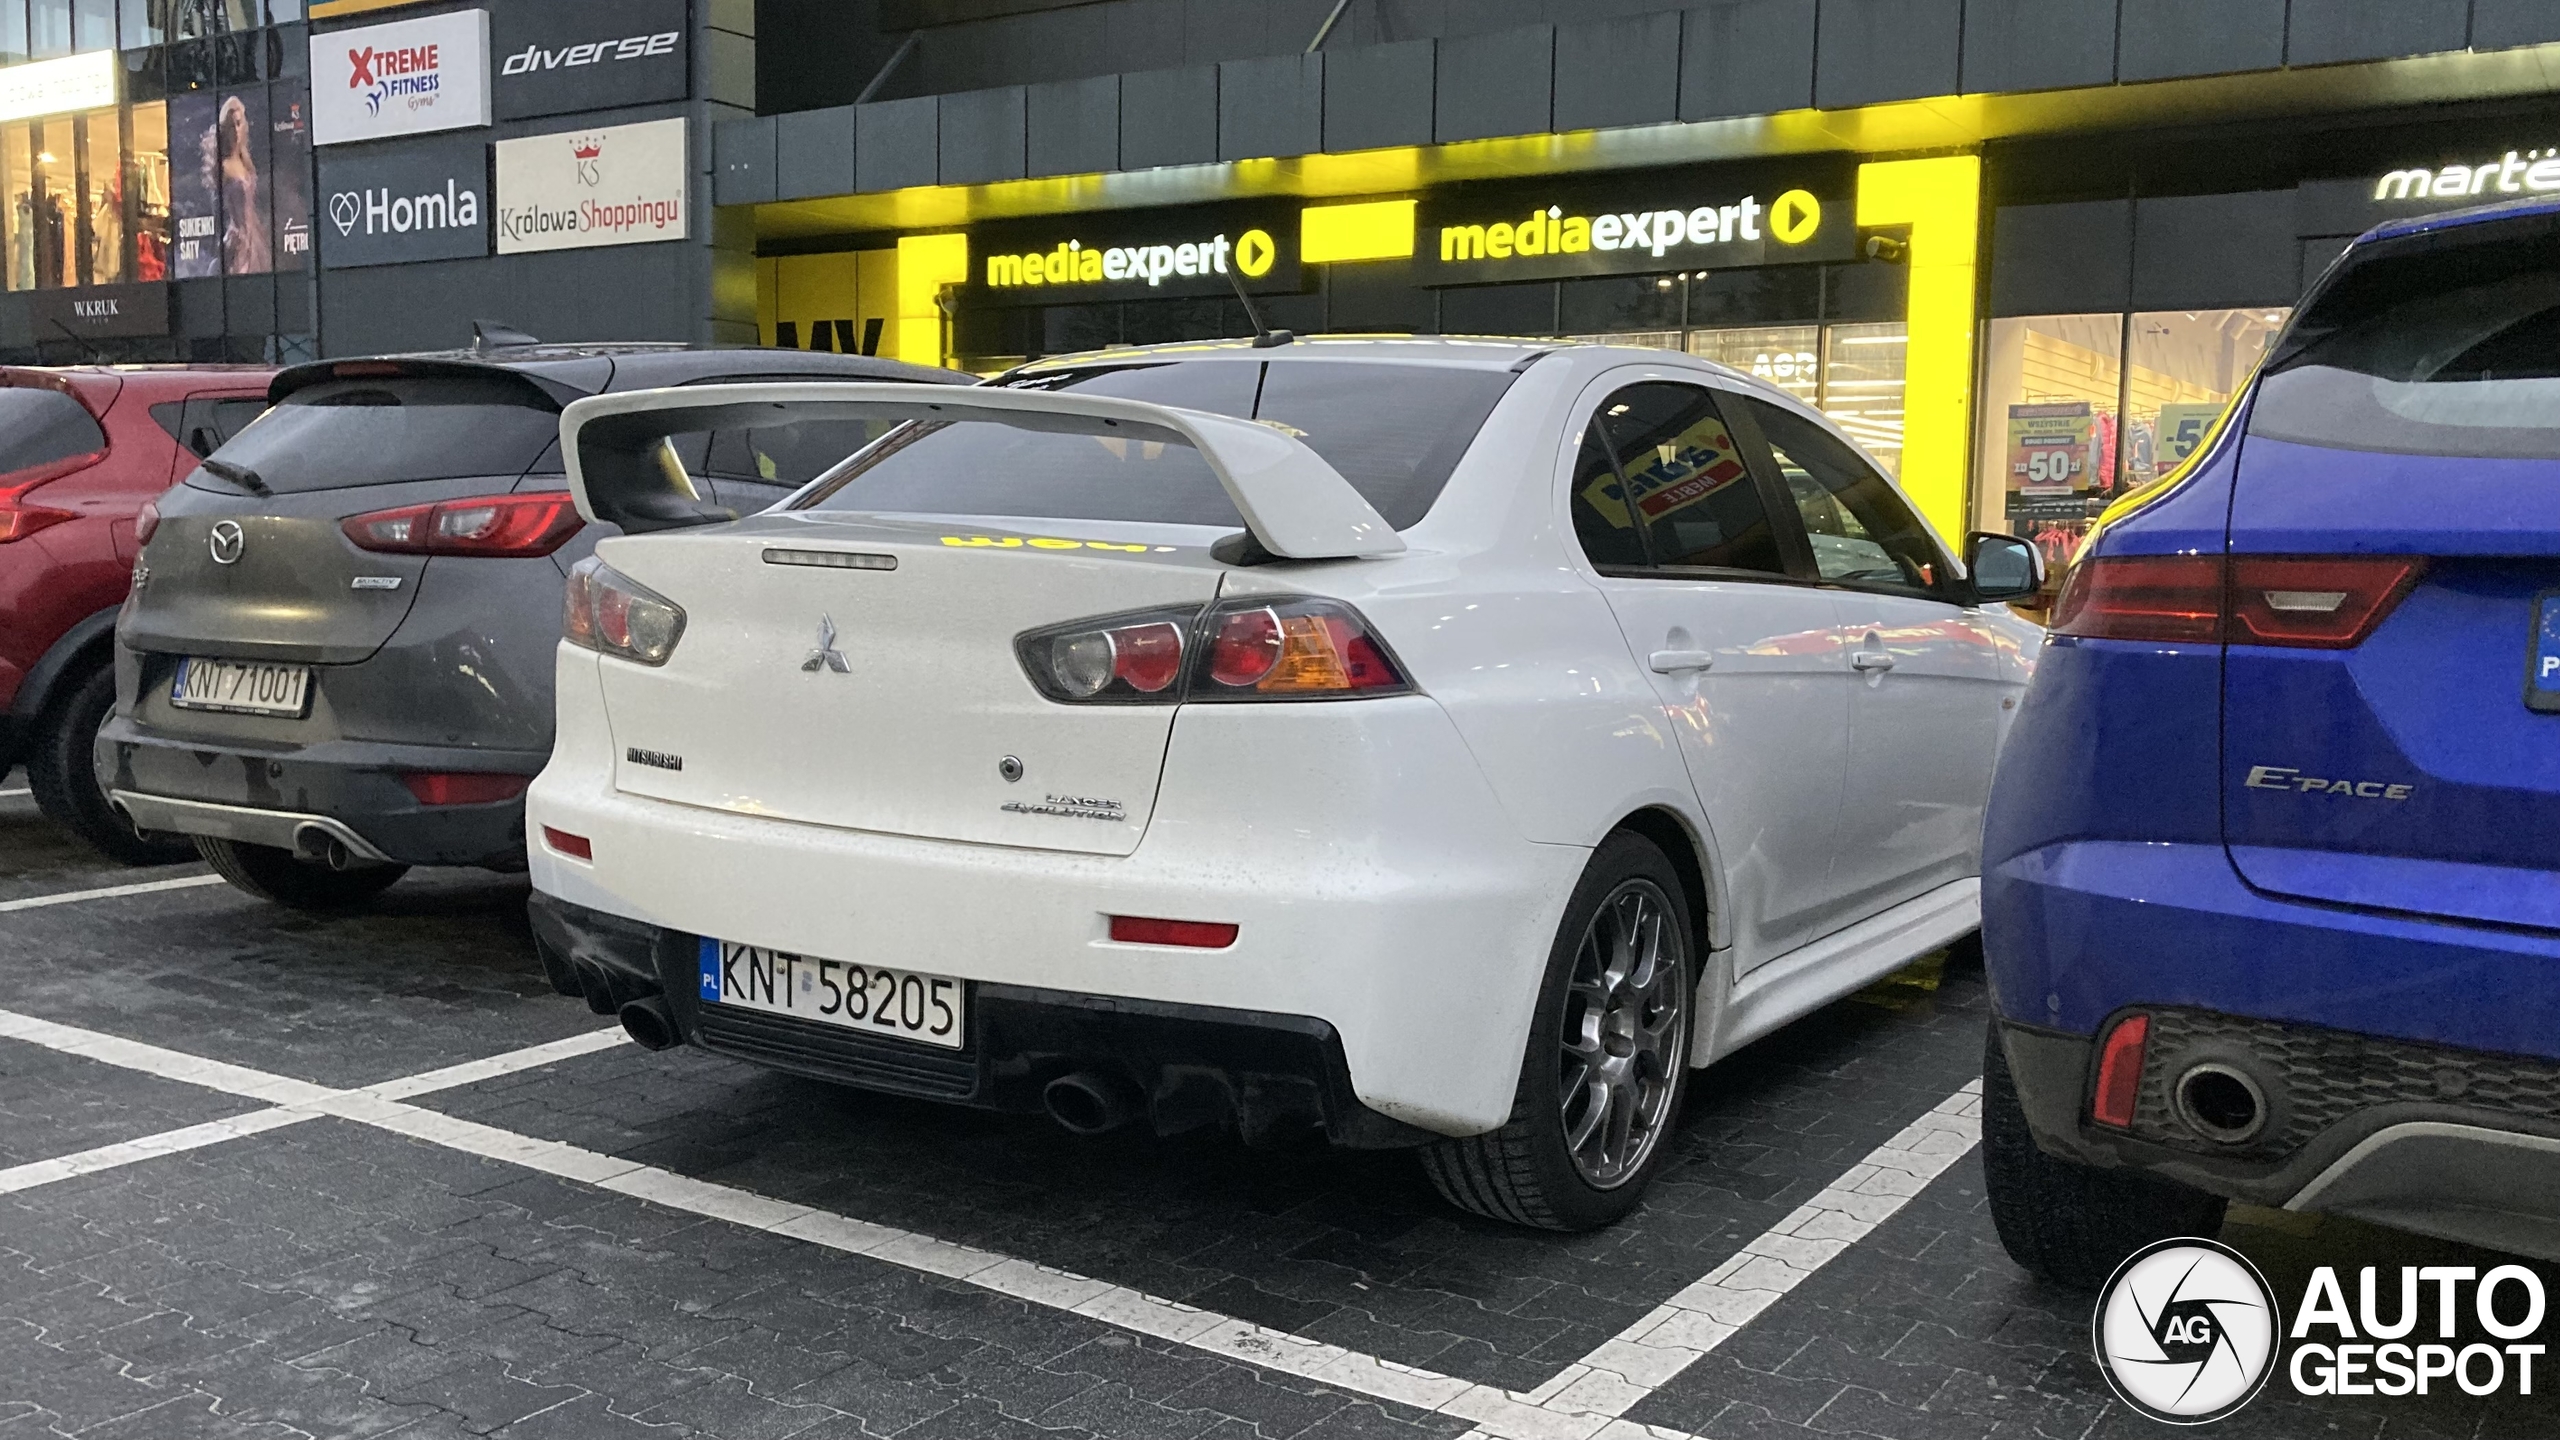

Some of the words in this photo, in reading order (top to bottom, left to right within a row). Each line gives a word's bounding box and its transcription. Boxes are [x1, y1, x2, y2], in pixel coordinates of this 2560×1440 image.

[348, 44, 439, 89] XTREME
[501, 30, 680, 76] diverse
[390, 73, 440, 97] FITNESS
[576, 159, 600, 188] KS
[366, 178, 478, 235] Homla
[178, 215, 215, 238] SUKIENKI
[1440, 195, 1762, 261] mediaexpert
[987, 234, 1230, 287] mediaexpert
[2028, 451, 2070, 482] 50
[183, 661, 228, 699] KNT
[229, 663, 303, 705] 71001
[626, 747, 683, 771] MITSUBISHI
[2244, 765, 2413, 800] E-PACE
[1000, 801, 1127, 821] EVOLUTION
[1046, 794, 1123, 809] LANCER
[702, 973, 718, 990] PL
[722, 943, 802, 1008] KNT
[819, 958, 954, 1036] 58205
